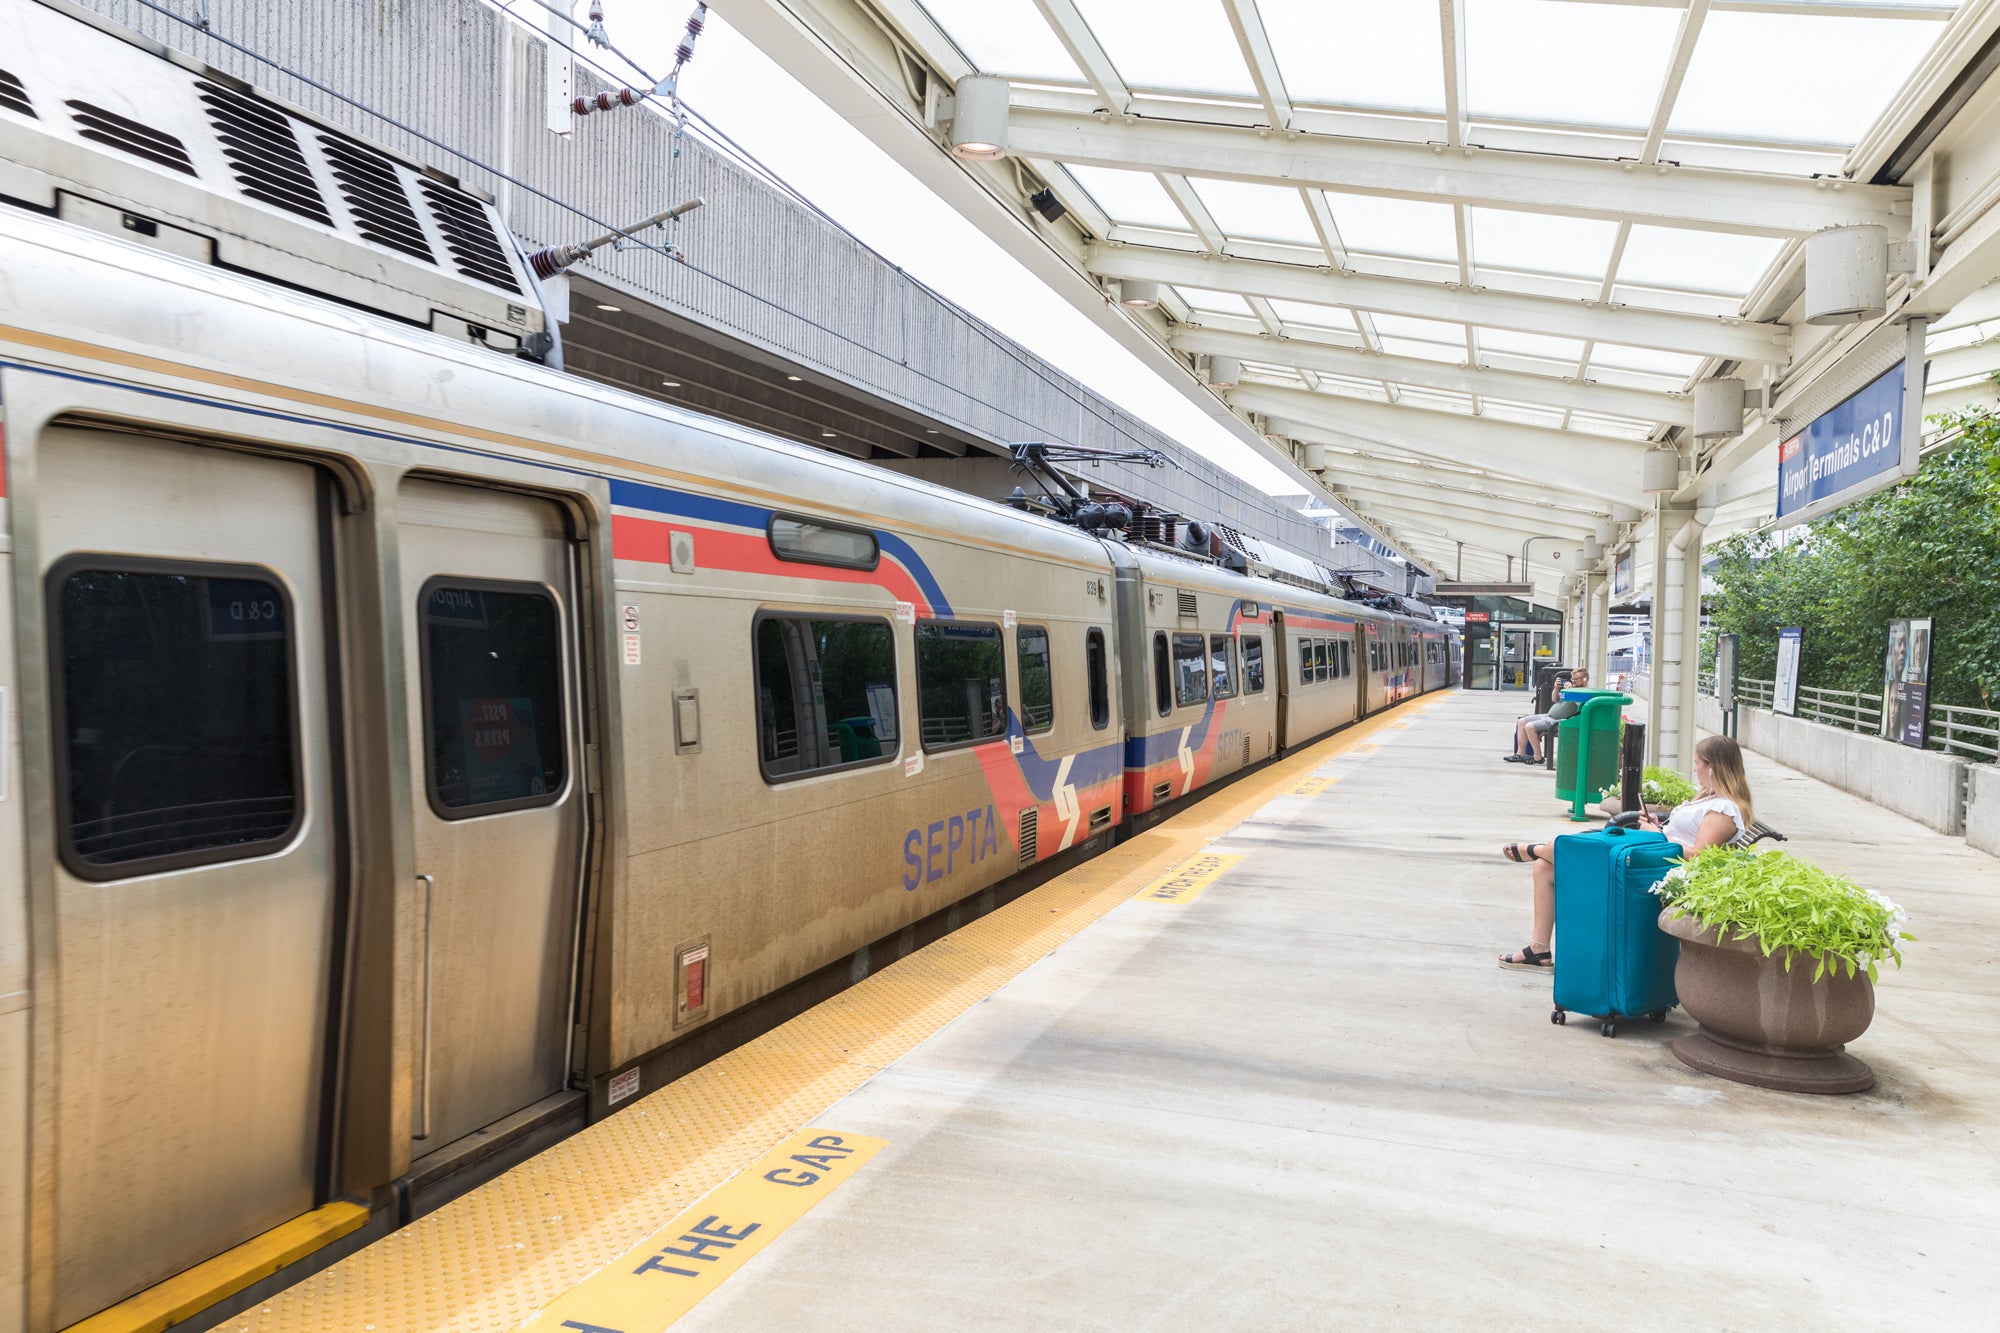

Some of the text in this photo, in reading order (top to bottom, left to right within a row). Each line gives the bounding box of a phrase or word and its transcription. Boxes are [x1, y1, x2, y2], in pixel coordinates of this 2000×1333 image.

[1783, 461, 1809, 500] Airport
[1809, 433, 1860, 482] Terminals
[903, 804, 998, 892] SEPTA
[632, 1135, 855, 1277] THE GAP
